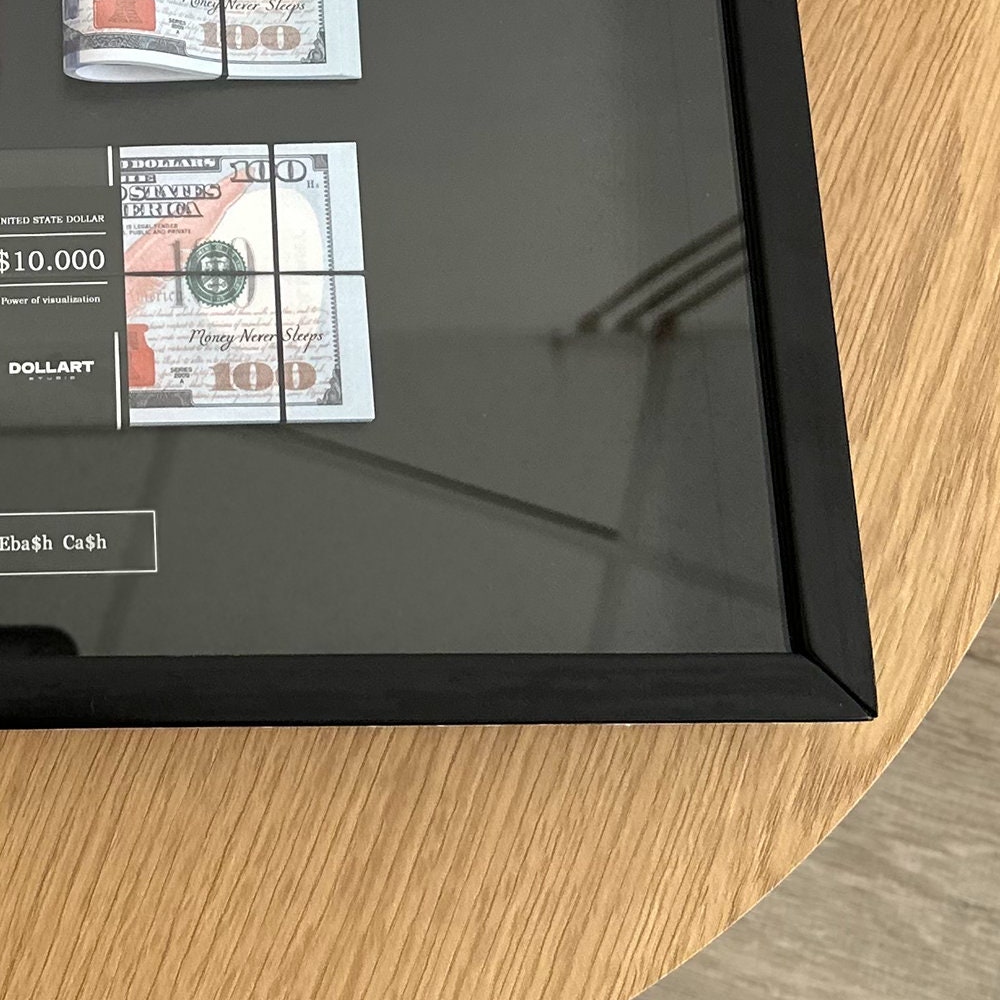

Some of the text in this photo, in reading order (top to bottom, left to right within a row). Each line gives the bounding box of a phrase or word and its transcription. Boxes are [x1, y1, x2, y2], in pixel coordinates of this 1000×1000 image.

[199, 22, 301, 50] 100
[131, 158, 217, 169] DOLLARS
[230, 160, 307, 182] 100
[129, 183, 222, 201] STATES
[122, 201, 204, 218] ERICA
[32, 216, 64, 225] STATE
[66, 214, 105, 223] DOLLAR
[1, 296, 28, 305] Power
[31, 296, 40, 304] of
[189, 324, 324, 353] Money Never Sleeps
[8, 360, 95, 374] DOLLART
[209, 361, 317, 391] 100
[62, 533, 107, 552] Ca$h
